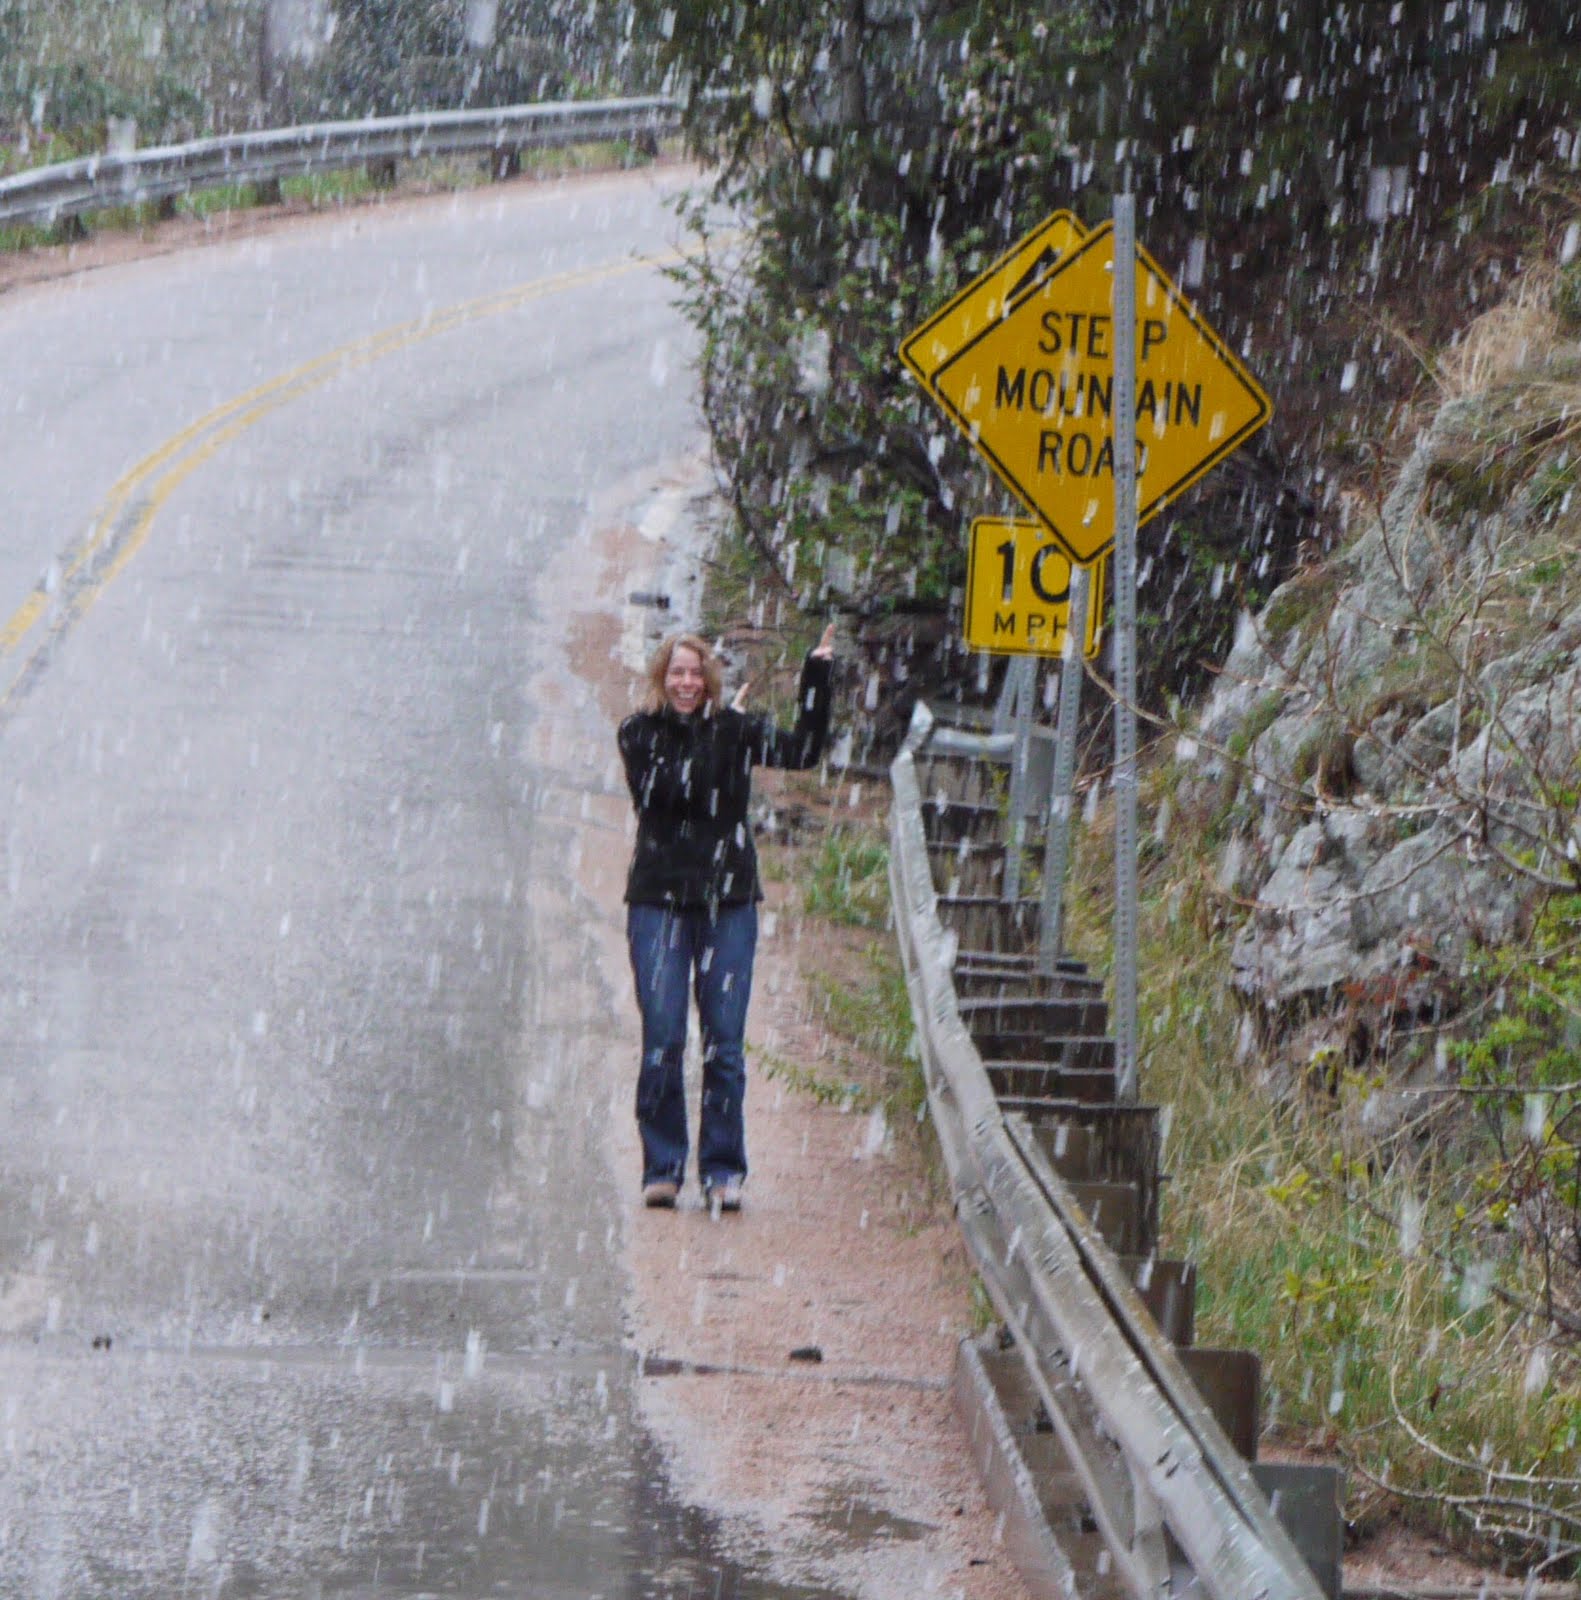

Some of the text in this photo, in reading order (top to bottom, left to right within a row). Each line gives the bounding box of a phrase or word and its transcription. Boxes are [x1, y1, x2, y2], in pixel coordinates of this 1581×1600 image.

[1038, 311, 1167, 361] STEP
[995, 365, 1202, 428] MOUNAIN
[997, 540, 1073, 604] 10
